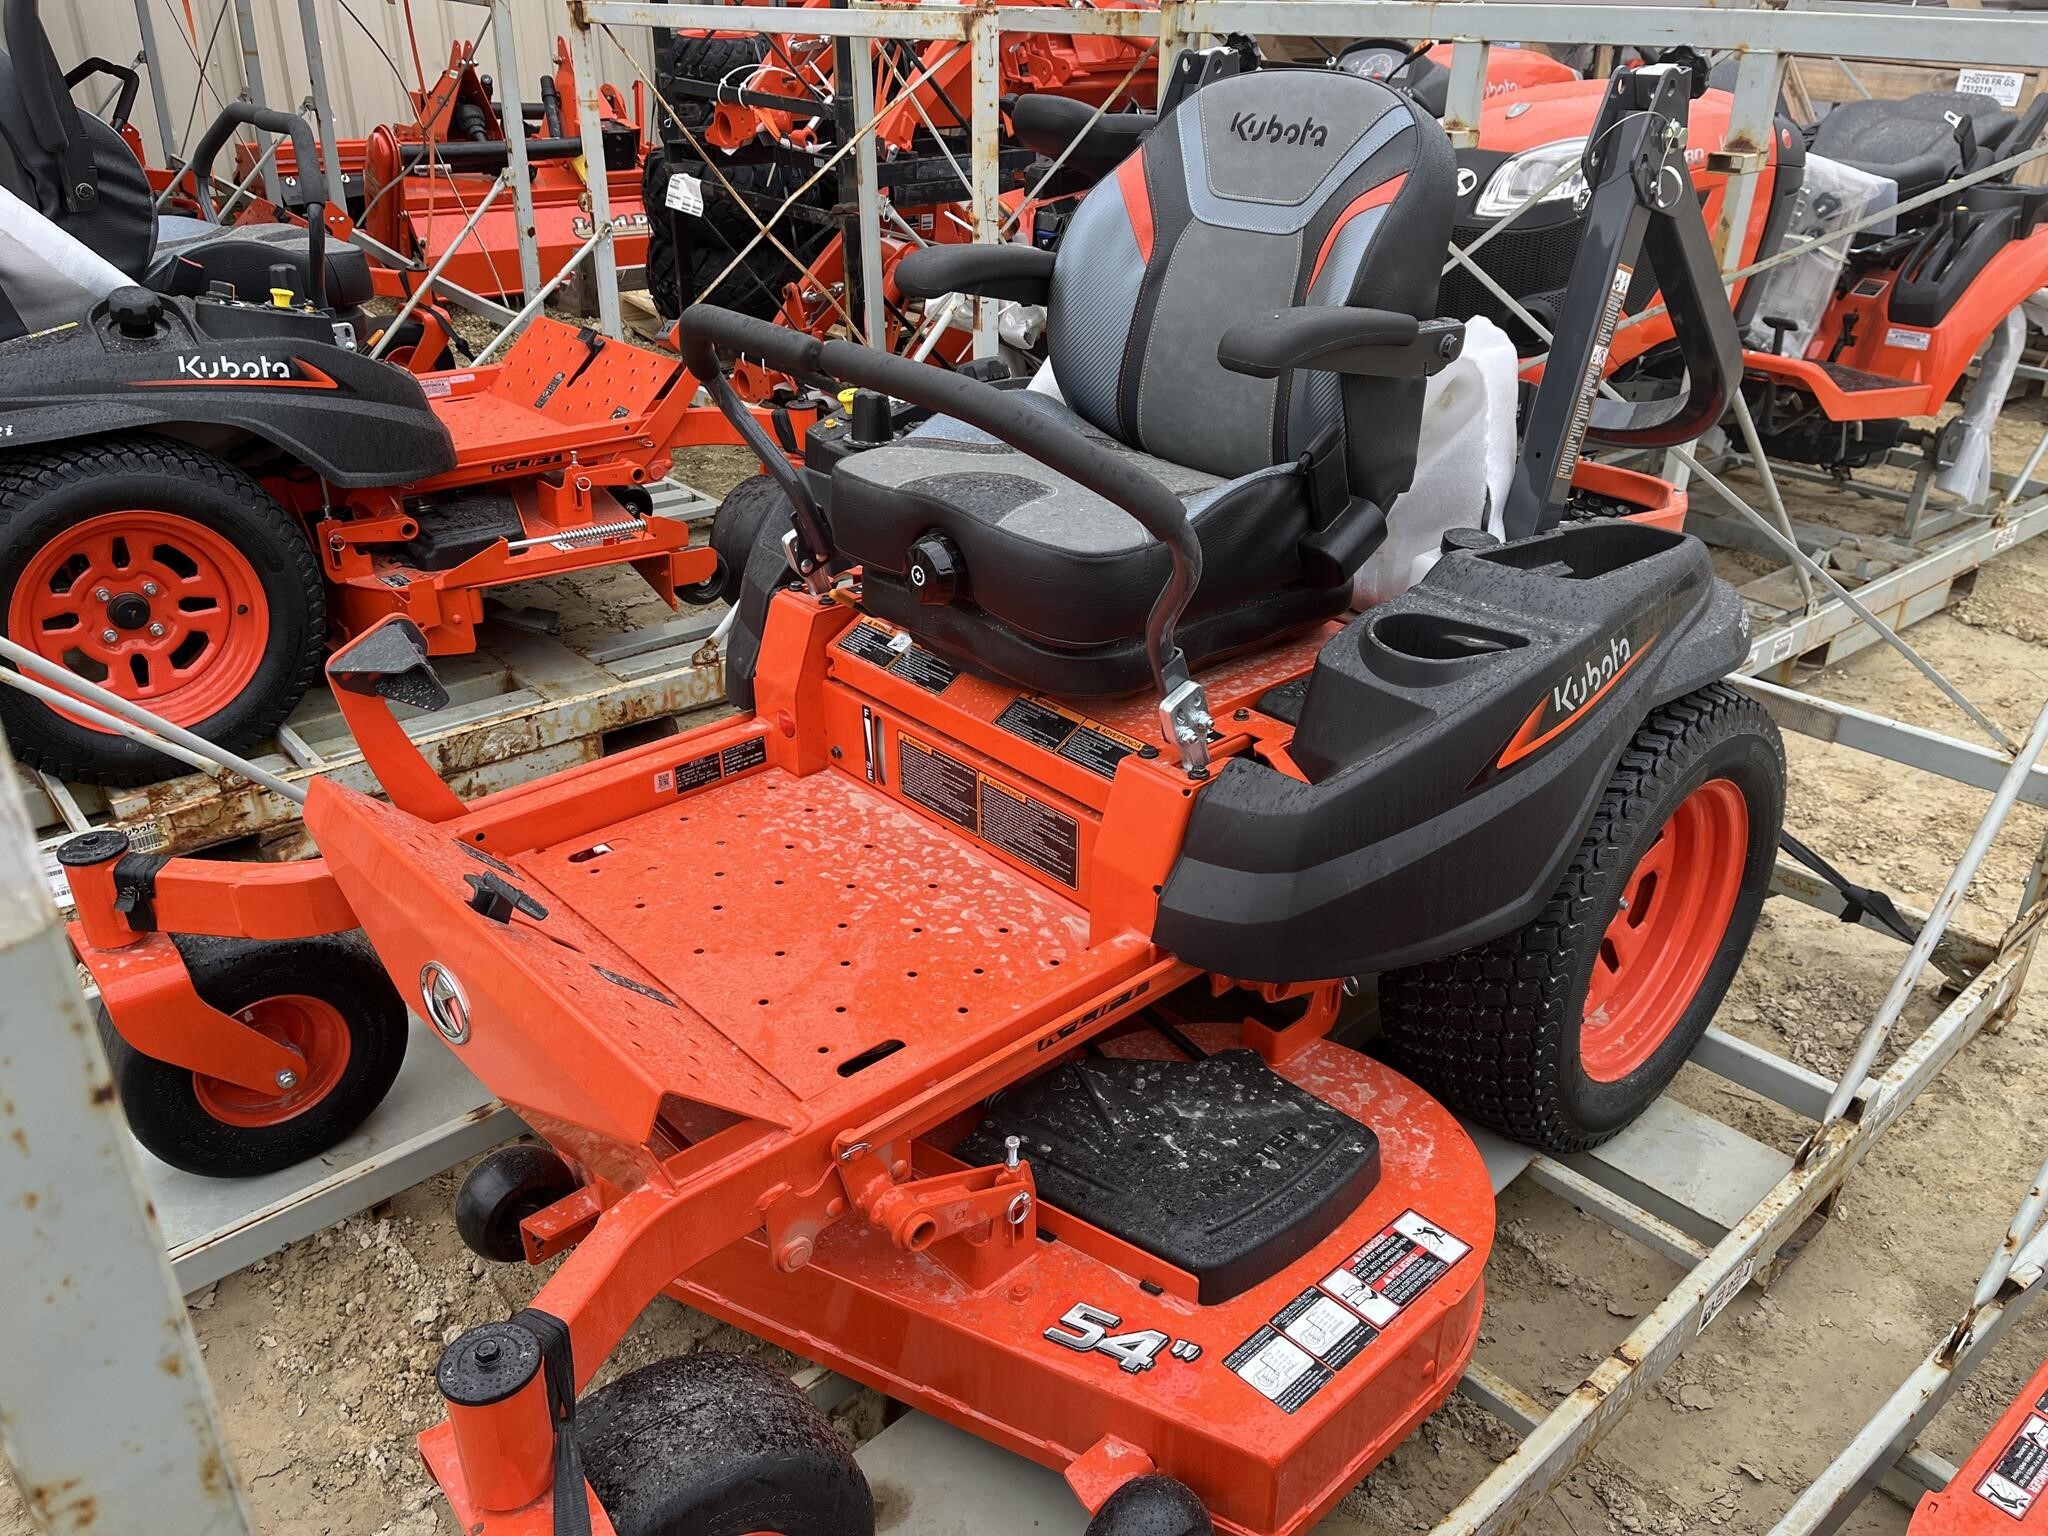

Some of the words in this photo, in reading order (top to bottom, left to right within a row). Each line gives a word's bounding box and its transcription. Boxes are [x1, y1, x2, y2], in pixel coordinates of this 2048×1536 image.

[1229, 111, 1328, 147] Kubota
[177, 354, 291, 379] Kubota
[1553, 636, 1631, 713] Kubota
[863, 708, 871, 718] F
[1101, 727, 1142, 750] ADVERTENCIA
[866, 770, 874, 780] E
[988, 778, 1025, 801] ADVERTENCIA
[1039, 983, 1145, 1051] K-LIFT
[1349, 1266, 1360, 1274] DO
[1356, 1259, 1369, 1268] NOT
[1365, 1251, 1378, 1261] PUT
[1373, 1240, 1391, 1254] HANDS
[1387, 1235, 1397, 1243] OR
[1357, 1232, 1388, 1259] DANGER
[1357, 1267, 1371, 1279] FEET
[1367, 1259, 1381, 1269] INTO
[1377, 1246, 1397, 1261] MOWER
[1392, 1236, 1408, 1248] WHEN
[1387, 1252, 1418, 1279] PELIGRO
[1043, 1301, 1203, 1375] 54"
